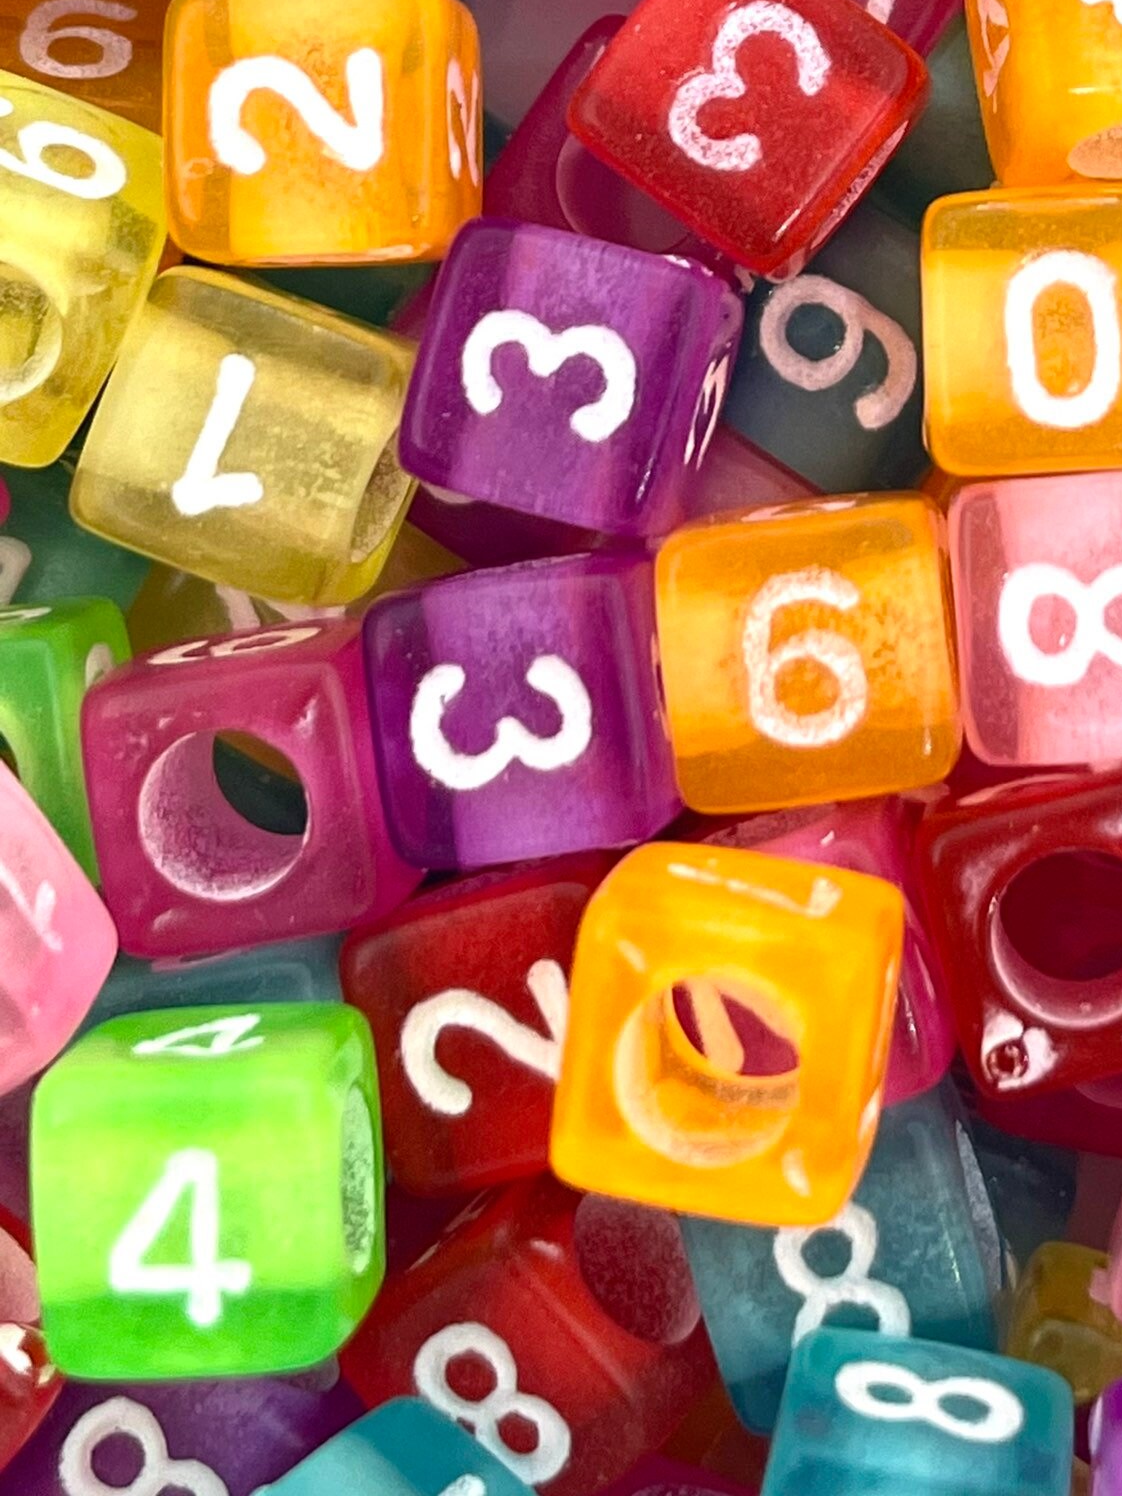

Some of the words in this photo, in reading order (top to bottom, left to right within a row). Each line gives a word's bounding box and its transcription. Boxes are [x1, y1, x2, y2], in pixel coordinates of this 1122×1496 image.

[209, 47, 384, 175] 2
[668, 0, 831, 171] 3
[462, 310, 635, 442] 3
[1003, 250, 1122, 428] 0
[411, 655, 591, 790] 3
[740, 570, 868, 747] 6
[401, 960, 569, 1115] 2
[108, 1148, 252, 1327] 4
[414, 1323, 571, 1486] 8
[836, 1362, 1022, 1442] 8
